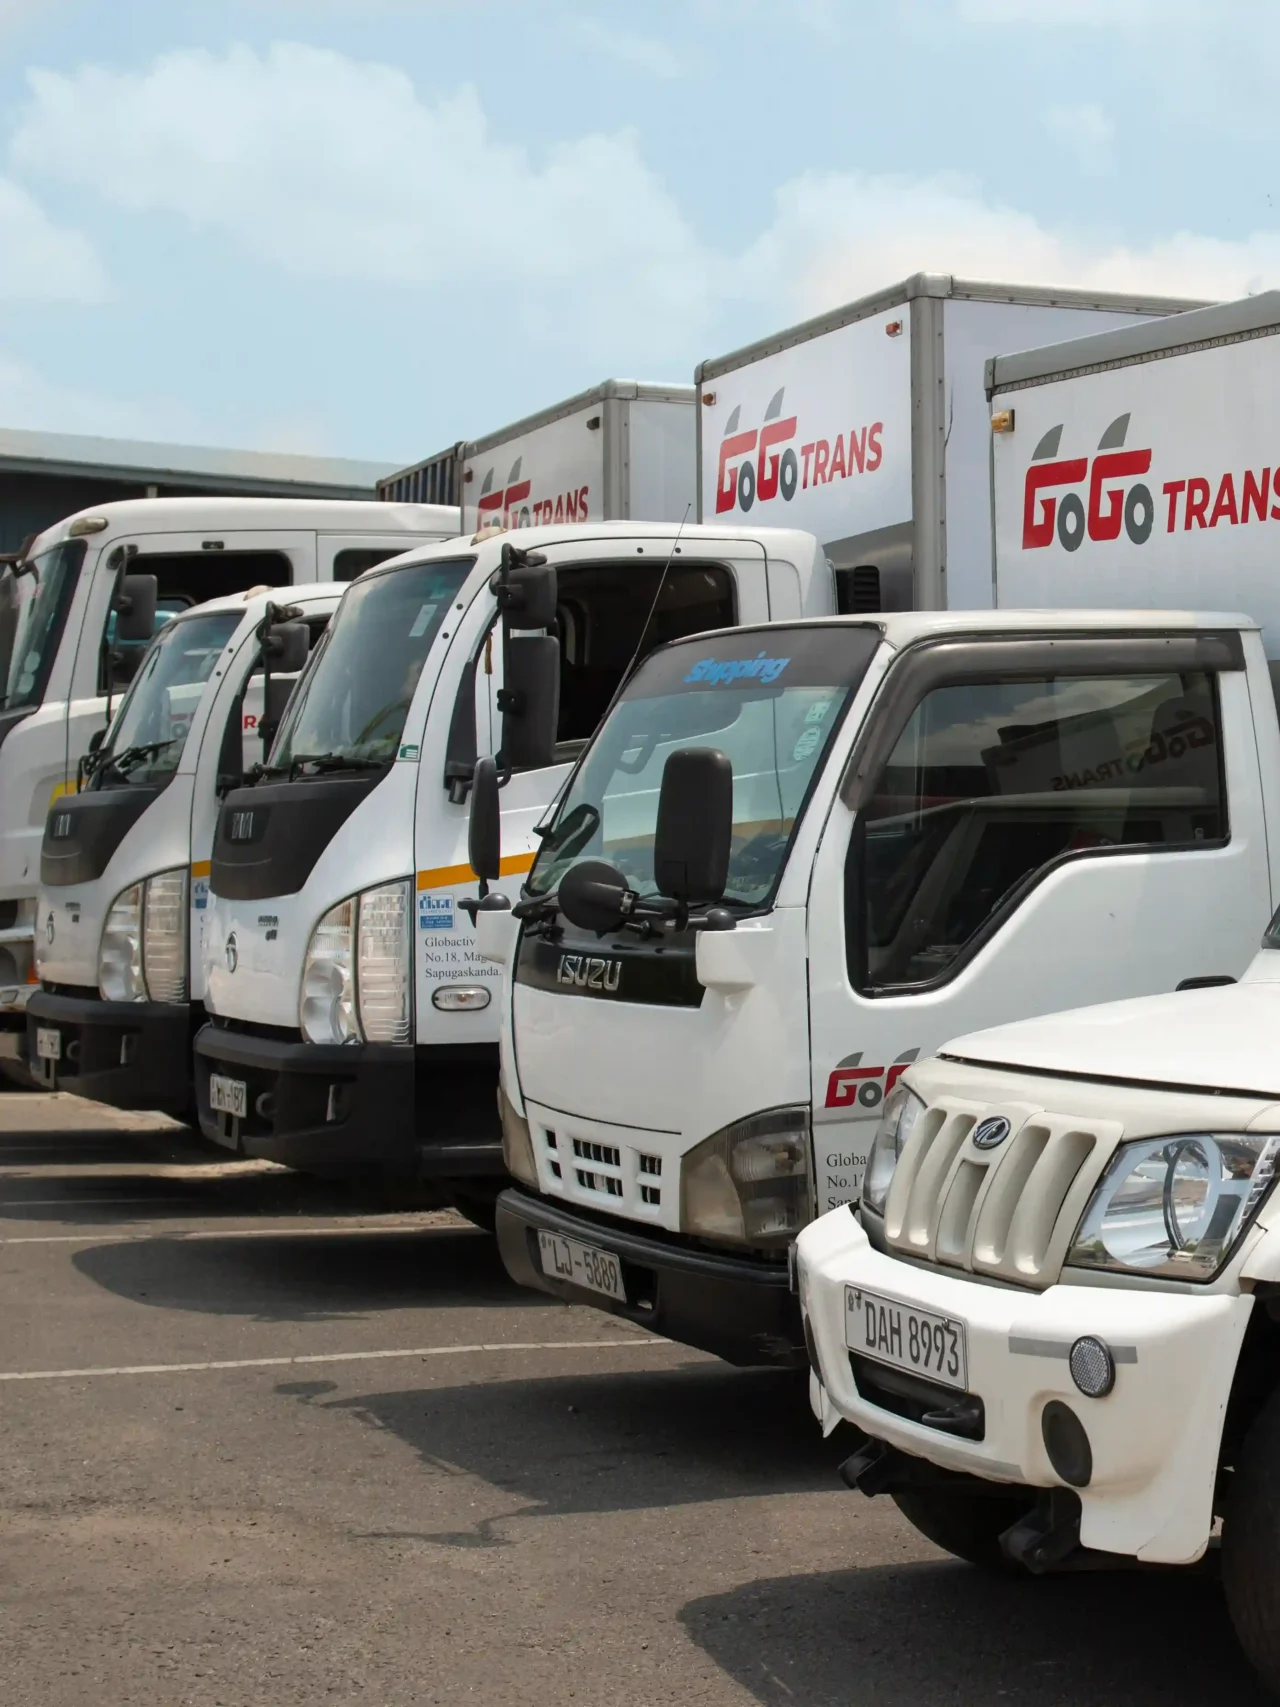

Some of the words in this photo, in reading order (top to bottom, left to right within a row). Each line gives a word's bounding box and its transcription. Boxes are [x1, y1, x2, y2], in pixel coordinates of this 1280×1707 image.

[716, 416, 798, 514] GoGo
[801, 422, 883, 489] TRANS
[533, 486, 589, 526] TRANS
[1022, 448, 1154, 552] GoGo
[684, 651, 791, 685] Shipping
[425, 937, 476, 947] Globactiv
[425, 952, 460, 964] No.18,
[464, 952, 488, 964] Mag
[425, 967, 502, 980] Sapugaskanda.
[557, 955, 622, 991] ISUZU
[826, 1153, 867, 1168] Globa
[826, 1173, 864, 1188] No.1
[553, 1240, 618, 1293] LJ-5889
[865, 1300, 902, 1358] DAH
[909, 1315, 959, 1377] 8993
